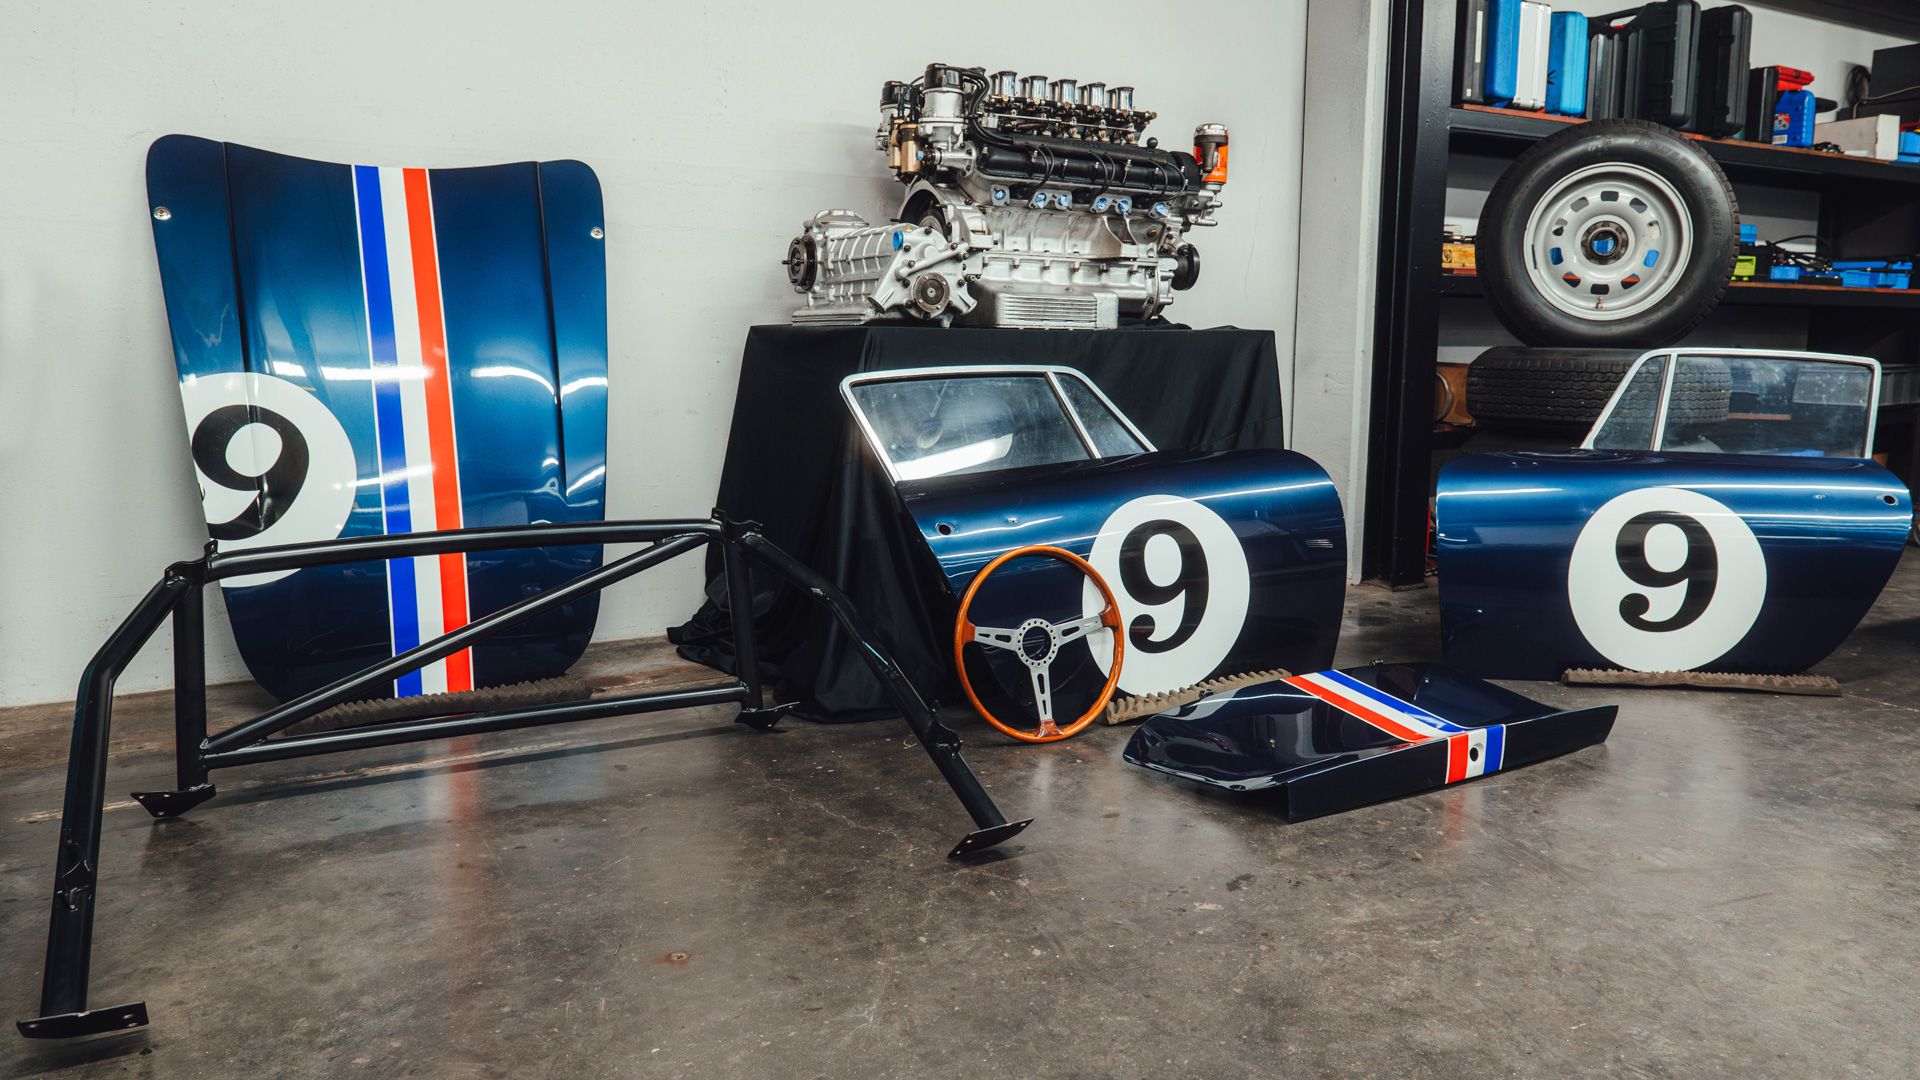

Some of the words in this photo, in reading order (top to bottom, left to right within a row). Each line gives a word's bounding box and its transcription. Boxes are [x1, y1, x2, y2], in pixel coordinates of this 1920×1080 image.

[1634, 135, 1699, 176] DUNLOP
[1701, 186, 1723, 245] RACING
[192, 404, 309, 540] 9
[1118, 519, 1210, 653] 9
[1615, 510, 1718, 632] 9
